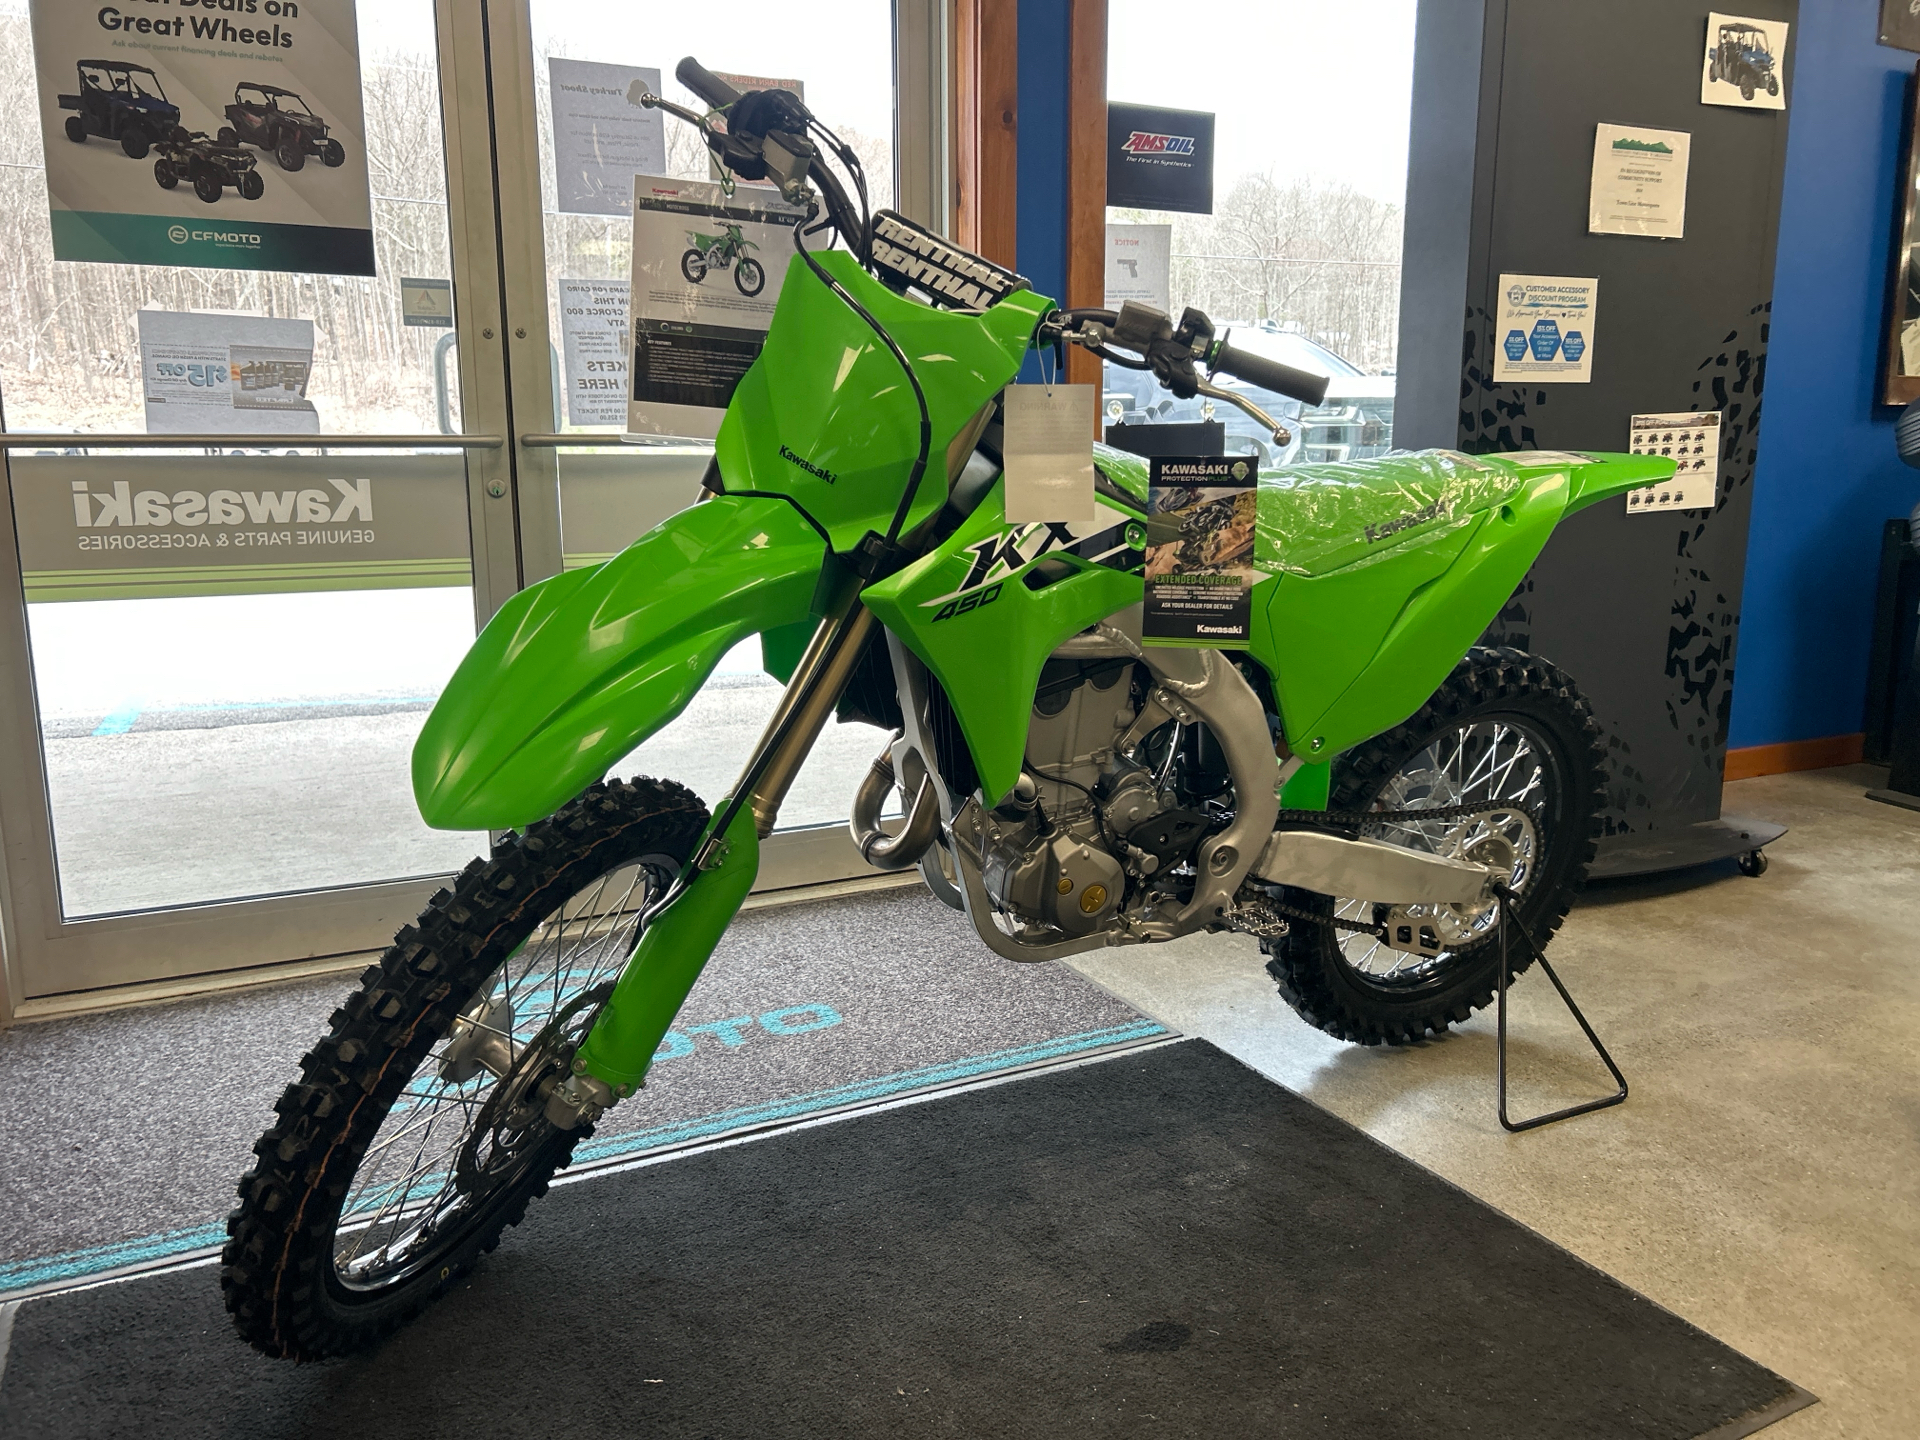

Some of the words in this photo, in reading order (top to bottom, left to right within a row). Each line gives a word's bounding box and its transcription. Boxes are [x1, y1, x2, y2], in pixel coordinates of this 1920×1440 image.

[180, 0, 258, 13] eals
[264, 1, 299, 18] on
[97, 7, 185, 37] Great
[190, 15, 293, 48] Wheels
[111, 39, 126, 48] Ask
[128, 41, 151, 51] about
[152, 43, 180, 53] current
[180, 45, 216, 58] financing
[217, 49, 238, 59] deals
[239, 52, 254, 60] and
[255, 53, 283, 63] rebates
[1121, 130, 1195, 156] AMSOIL
[1160, 159, 1193, 168] Synthetics
[191, 230, 262, 244] CFMOTO
[874, 217, 1010, 293] RENTHAL
[871, 238, 994, 312] RENTHAL
[1525, 285, 1557, 293] CUSTOMER
[1557, 286, 1590, 294] ACCESSORY
[1528, 294, 1558, 302] DISCOUNT
[1558, 295, 1586, 303] PROGRAM
[778, 444, 838, 485] Kawasaki
[1161, 464, 1229, 475] KAWASAKI
[1155, 574, 1197, 584] EXTENDED
[1198, 575, 1243, 586] COVERAGE
[931, 582, 1004, 623] 450
[1196, 624, 1243, 634] Kawasaki
